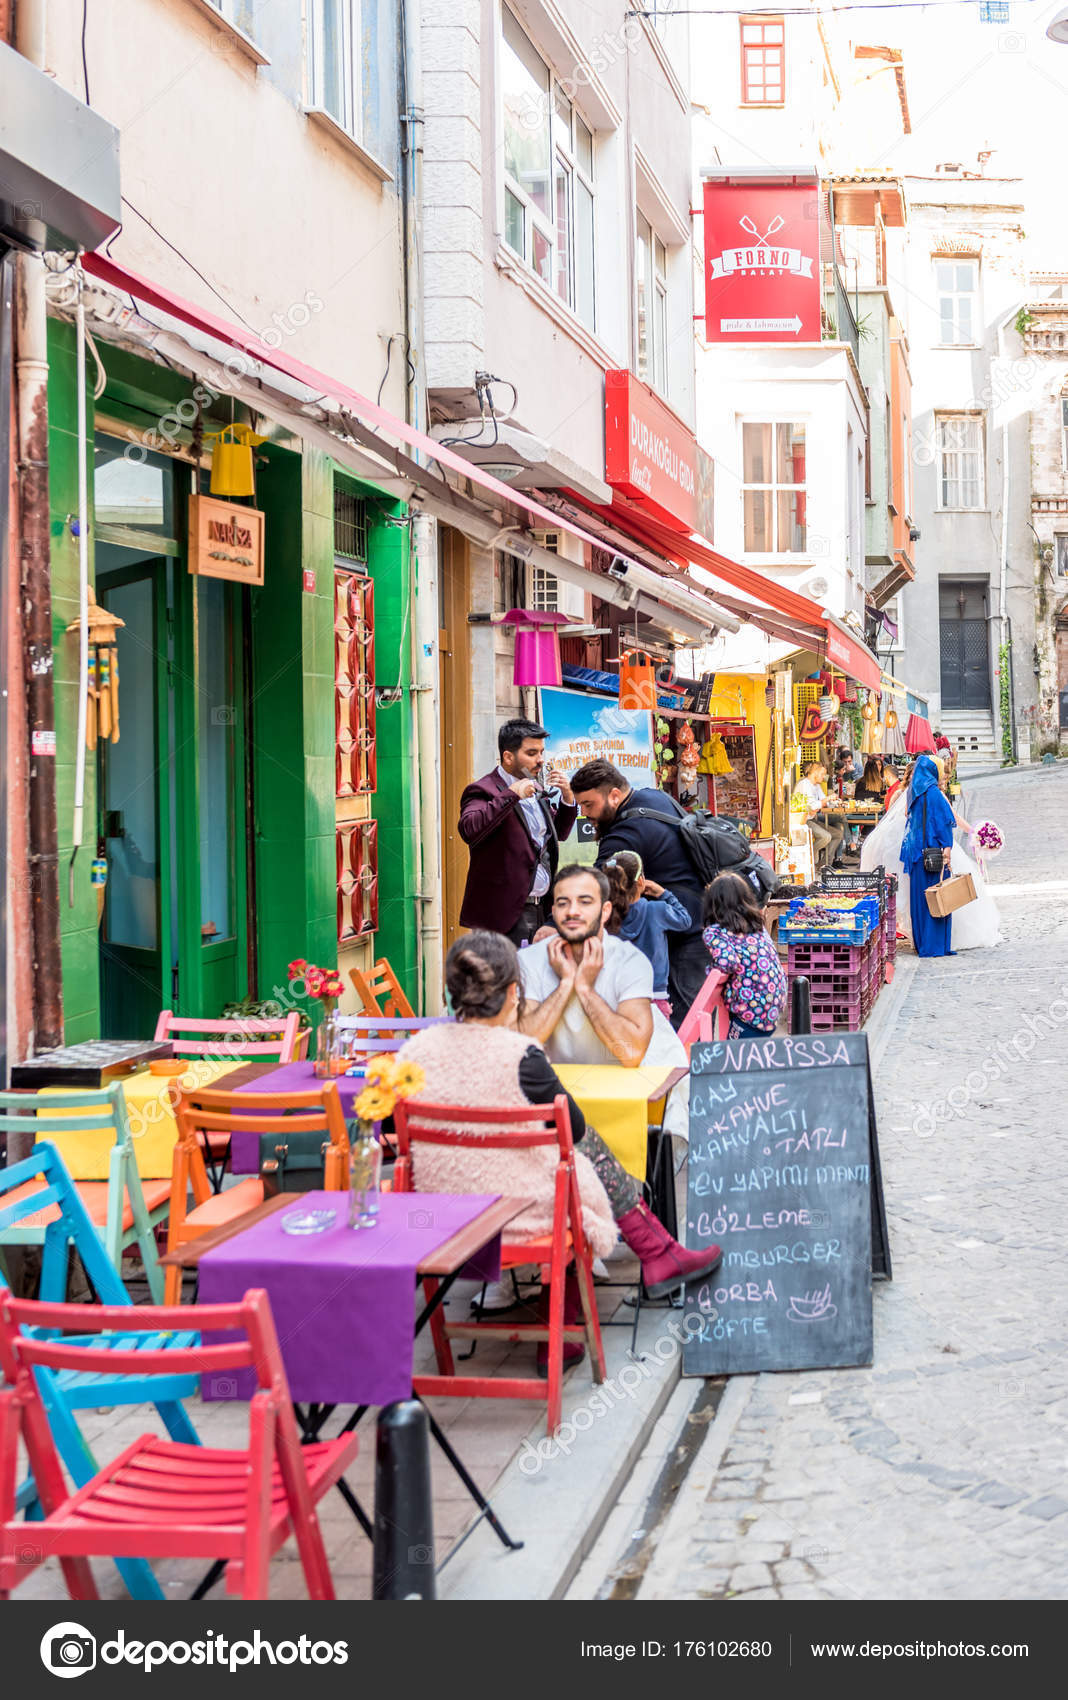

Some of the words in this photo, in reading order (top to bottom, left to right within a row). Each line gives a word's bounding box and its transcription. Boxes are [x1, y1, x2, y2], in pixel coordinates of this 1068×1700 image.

[735, 249, 790, 267] FORNO
[631, 413, 679, 482] DURAKOĞLU
[679, 459, 695, 497] GIDA
[691, 1043, 724, 1074] CAFE
[713, 1083, 789, 1135] KAHVE
[692, 1109, 808, 1162] KAHVALTI
[775, 1128, 847, 1154] TATLI
[694, 1172, 724, 1196] EV
[722, 1238, 841, 1267] MBURGER
[698, 1316, 769, 1344] KÖFTE
